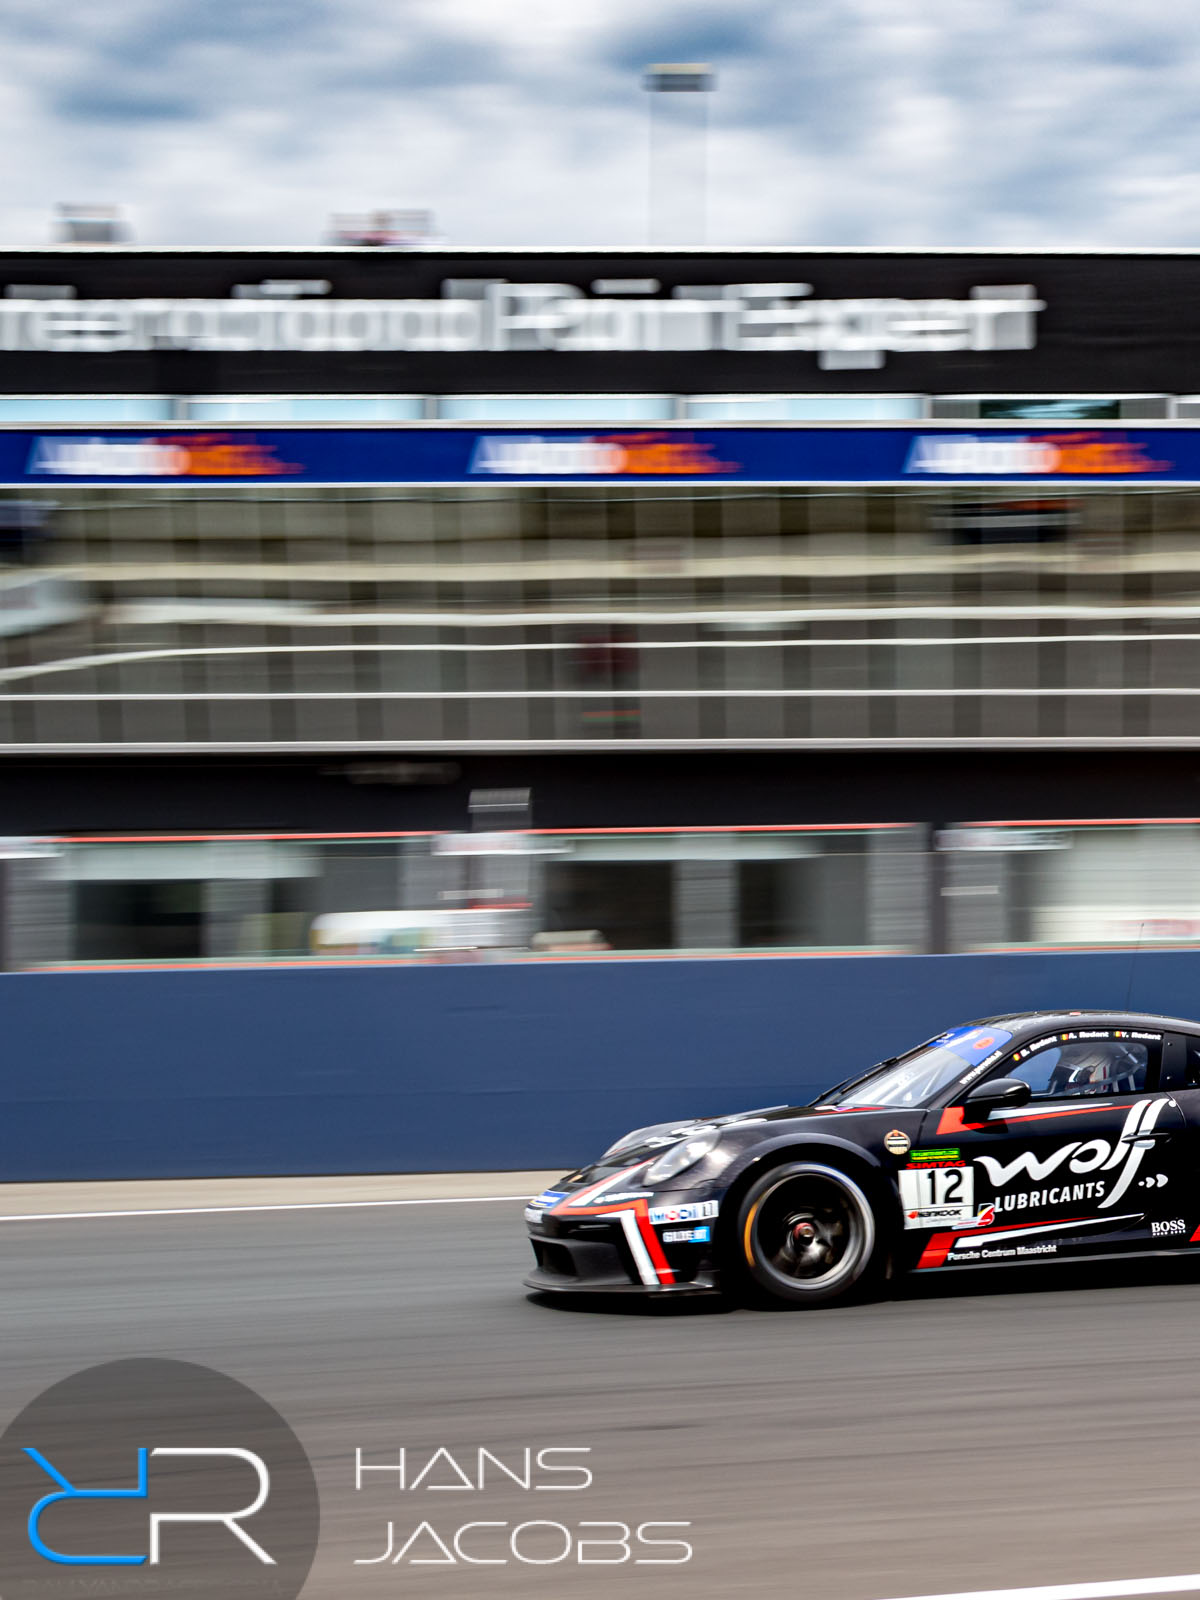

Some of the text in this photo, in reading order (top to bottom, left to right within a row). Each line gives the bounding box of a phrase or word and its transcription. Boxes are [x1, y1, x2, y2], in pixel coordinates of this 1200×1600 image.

[927, 1168, 964, 1205] 12
[994, 1180, 1105, 1213] LUBRICANTS
[1151, 1219, 1186, 1232] BOSS
[947, 1244, 1057, 1261] Porsche Centrum Maastricht
